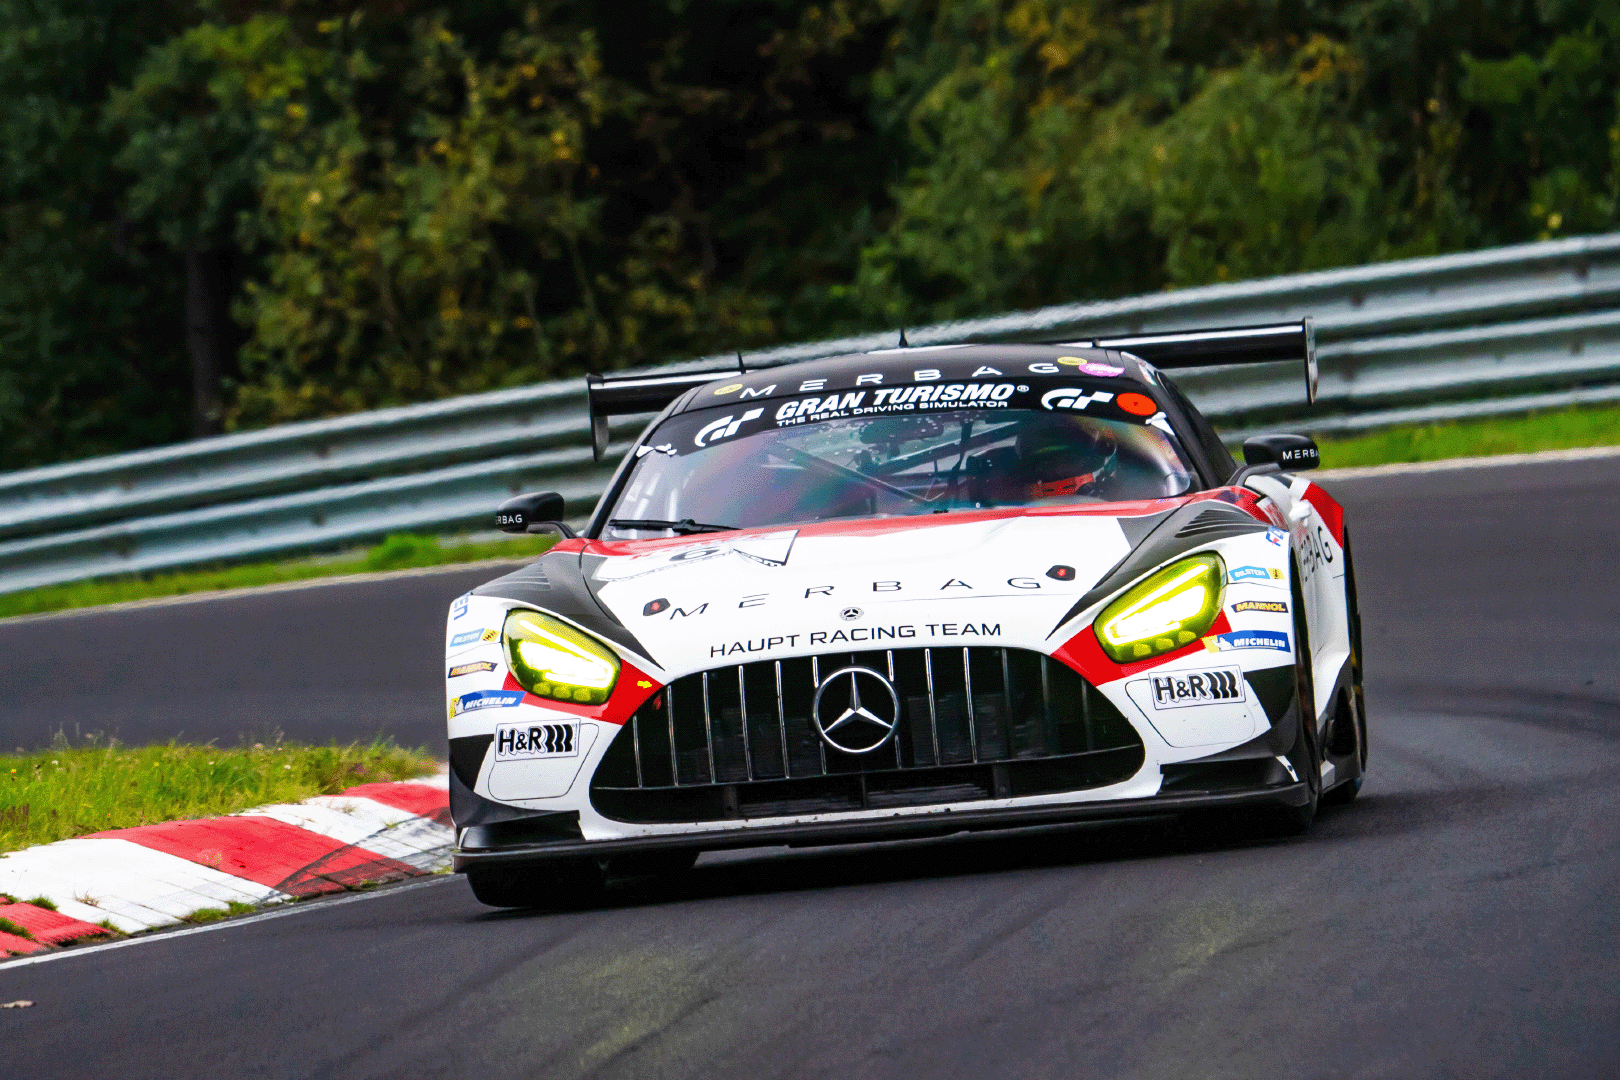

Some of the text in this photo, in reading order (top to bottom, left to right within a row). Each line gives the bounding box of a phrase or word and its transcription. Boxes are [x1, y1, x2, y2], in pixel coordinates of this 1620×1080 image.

[739, 362, 1060, 399] MERBAG
[775, 391, 867, 420] GRAN
[776, 400, 1008, 427] THE REAL DRIVING SIMULATOR
[669, 577, 1042, 620] MERBAG
[1236, 601, 1286, 612] MANNOL
[710, 623, 1001, 658] HAUPT RACING TEAM
[1233, 637, 1286, 648] MICHELIN
[1153, 674, 1208, 701] H&R
[464, 697, 517, 710] MICHELIN
[499, 727, 543, 754] H&R
